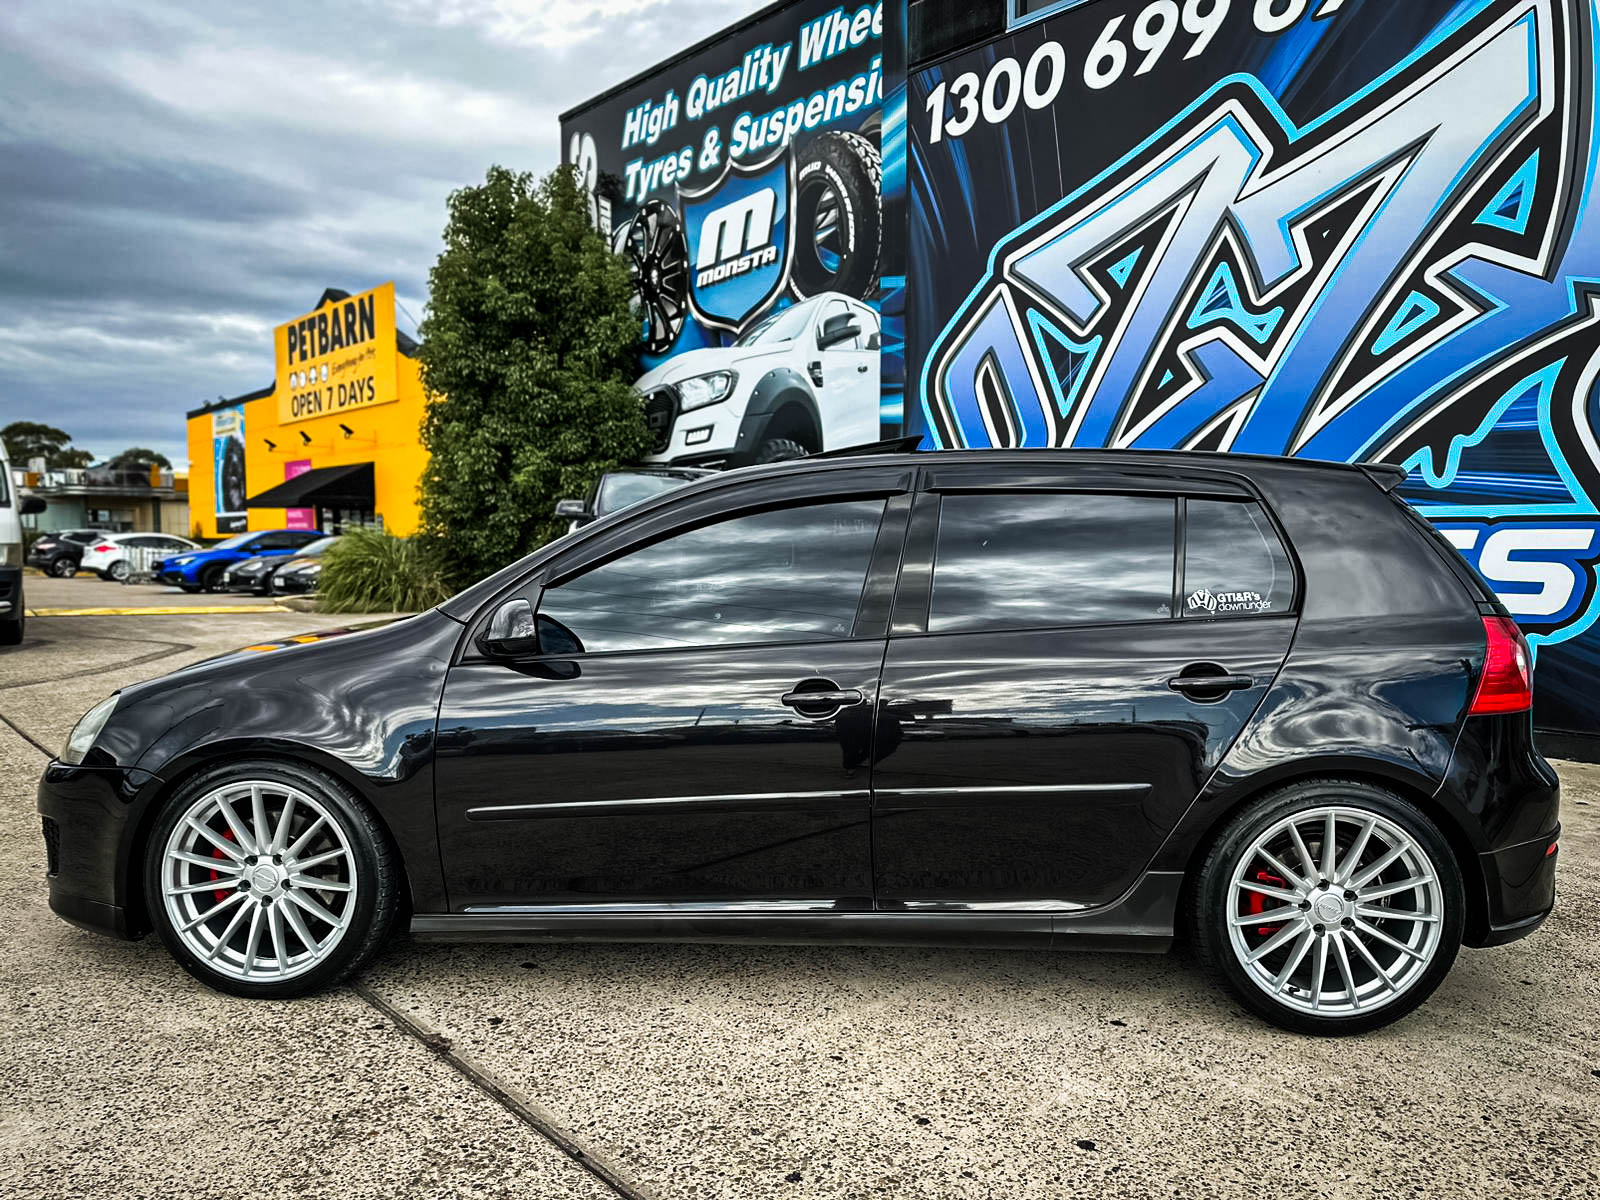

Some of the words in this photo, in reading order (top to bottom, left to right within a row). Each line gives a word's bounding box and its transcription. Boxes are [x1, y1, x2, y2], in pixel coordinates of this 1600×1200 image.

[622, 92, 679, 147] High
[687, 44, 791, 119] Quality
[925, 41, 1066, 144] 1300
[1083, 0, 1231, 90] 699
[625, 147, 694, 204] Tyres
[699, 127, 721, 172] &
[729, 58, 883, 158] Suspensi
[695, 245, 777, 288] MONSTA
[287, 294, 375, 365] PETBARN
[291, 389, 322, 418] OPEN
[326, 386, 334, 410] 7
[338, 375, 376, 407] DAYS
[1216, 591, 1261, 603] GTI&R's
[1217, 600, 1272, 612] downunder
